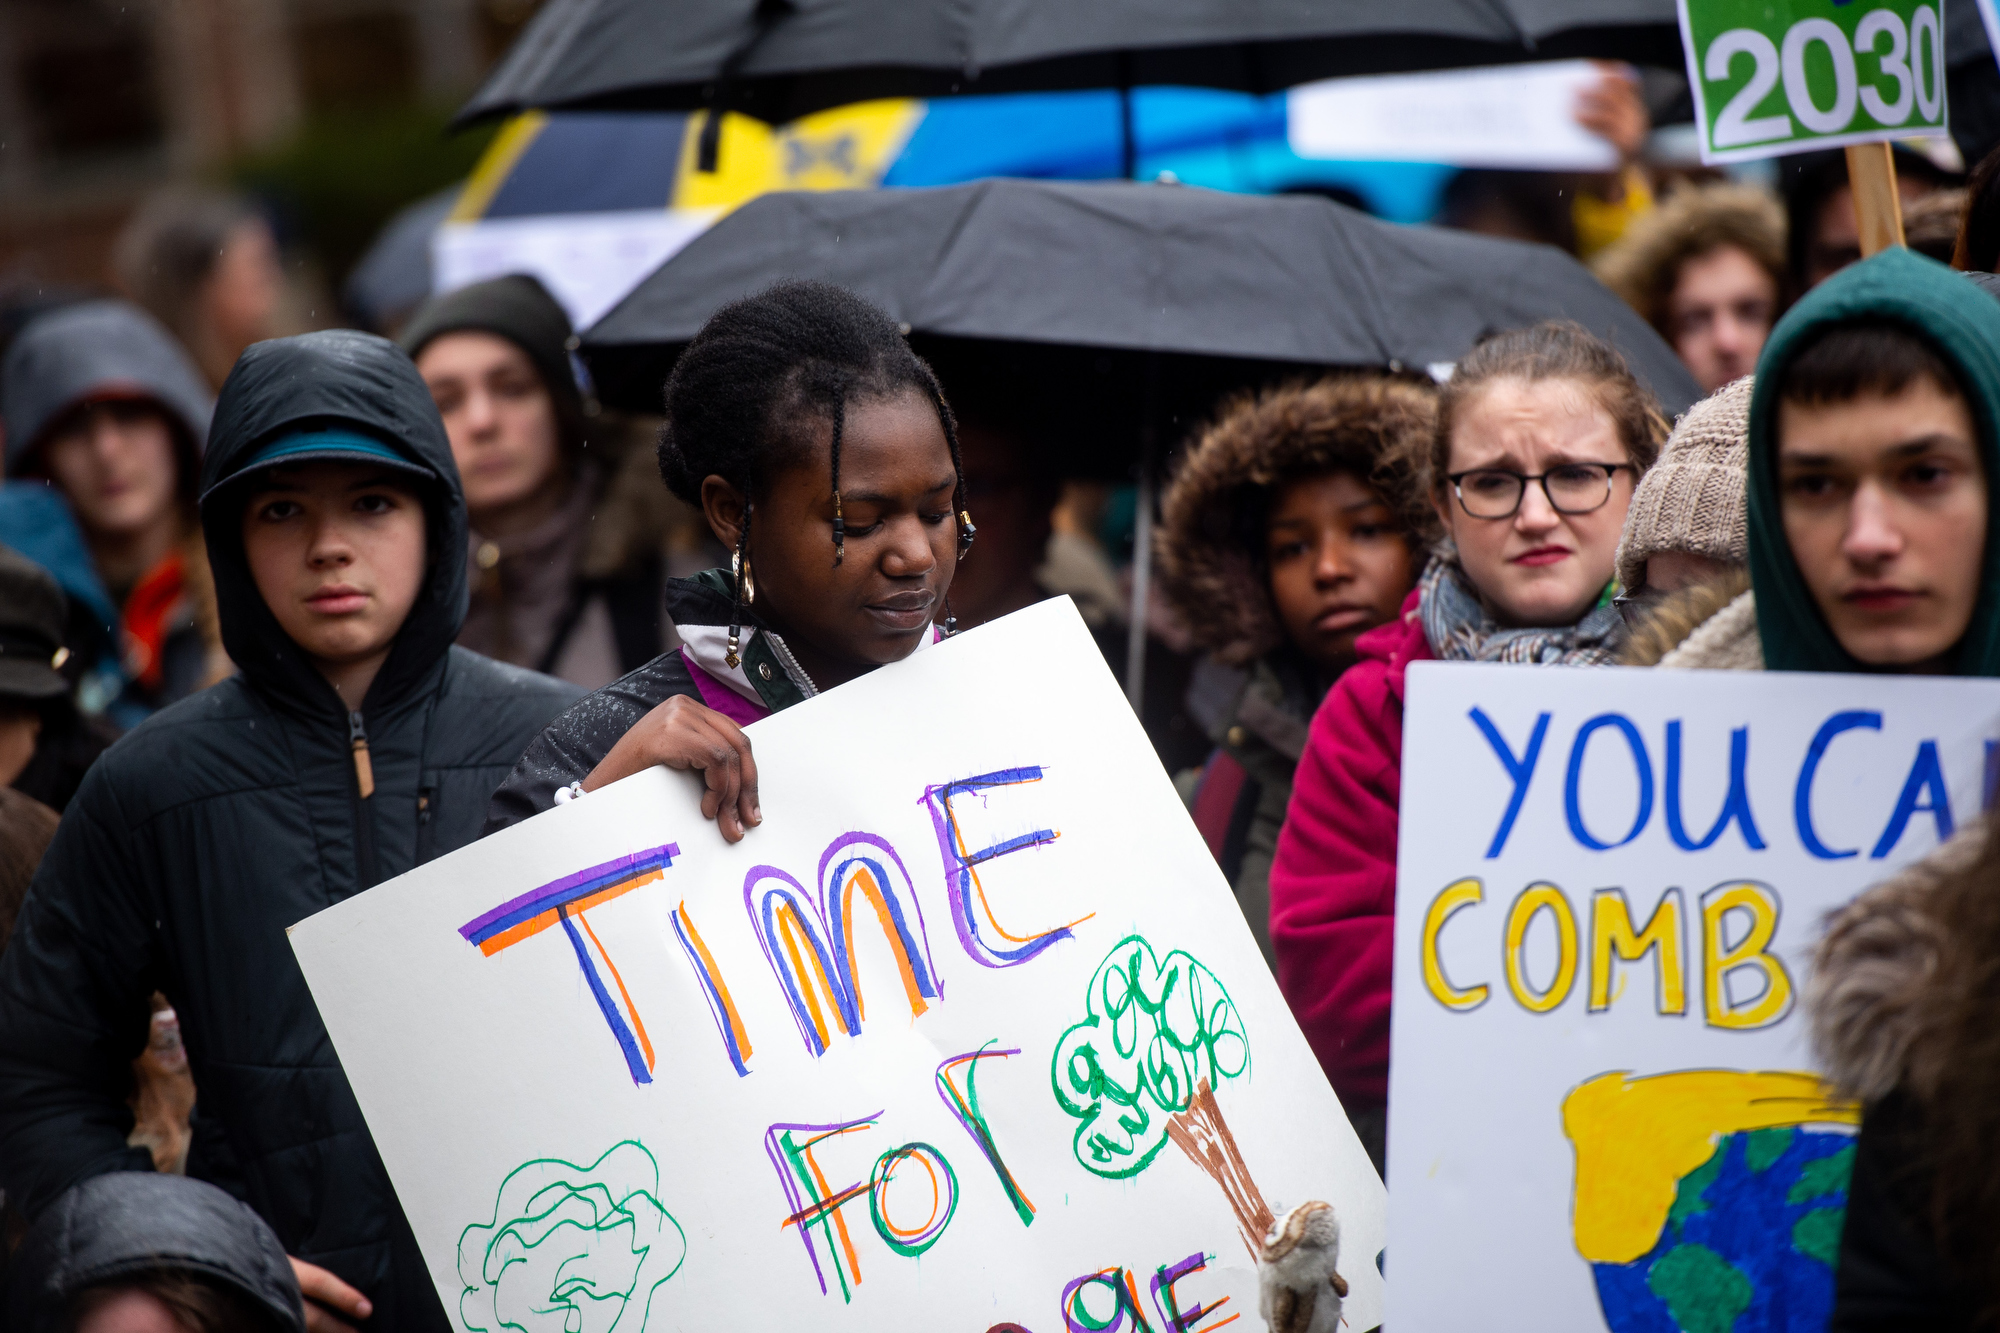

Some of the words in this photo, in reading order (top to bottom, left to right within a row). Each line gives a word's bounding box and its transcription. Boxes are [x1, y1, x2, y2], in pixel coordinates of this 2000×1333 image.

[1704, 4, 1943, 149] 2030
[1467, 706, 1768, 860] YOU
[1794, 709, 2000, 860] CA
[458, 765, 1097, 1089] TIME
[1420, 876, 1797, 1031] COMB
